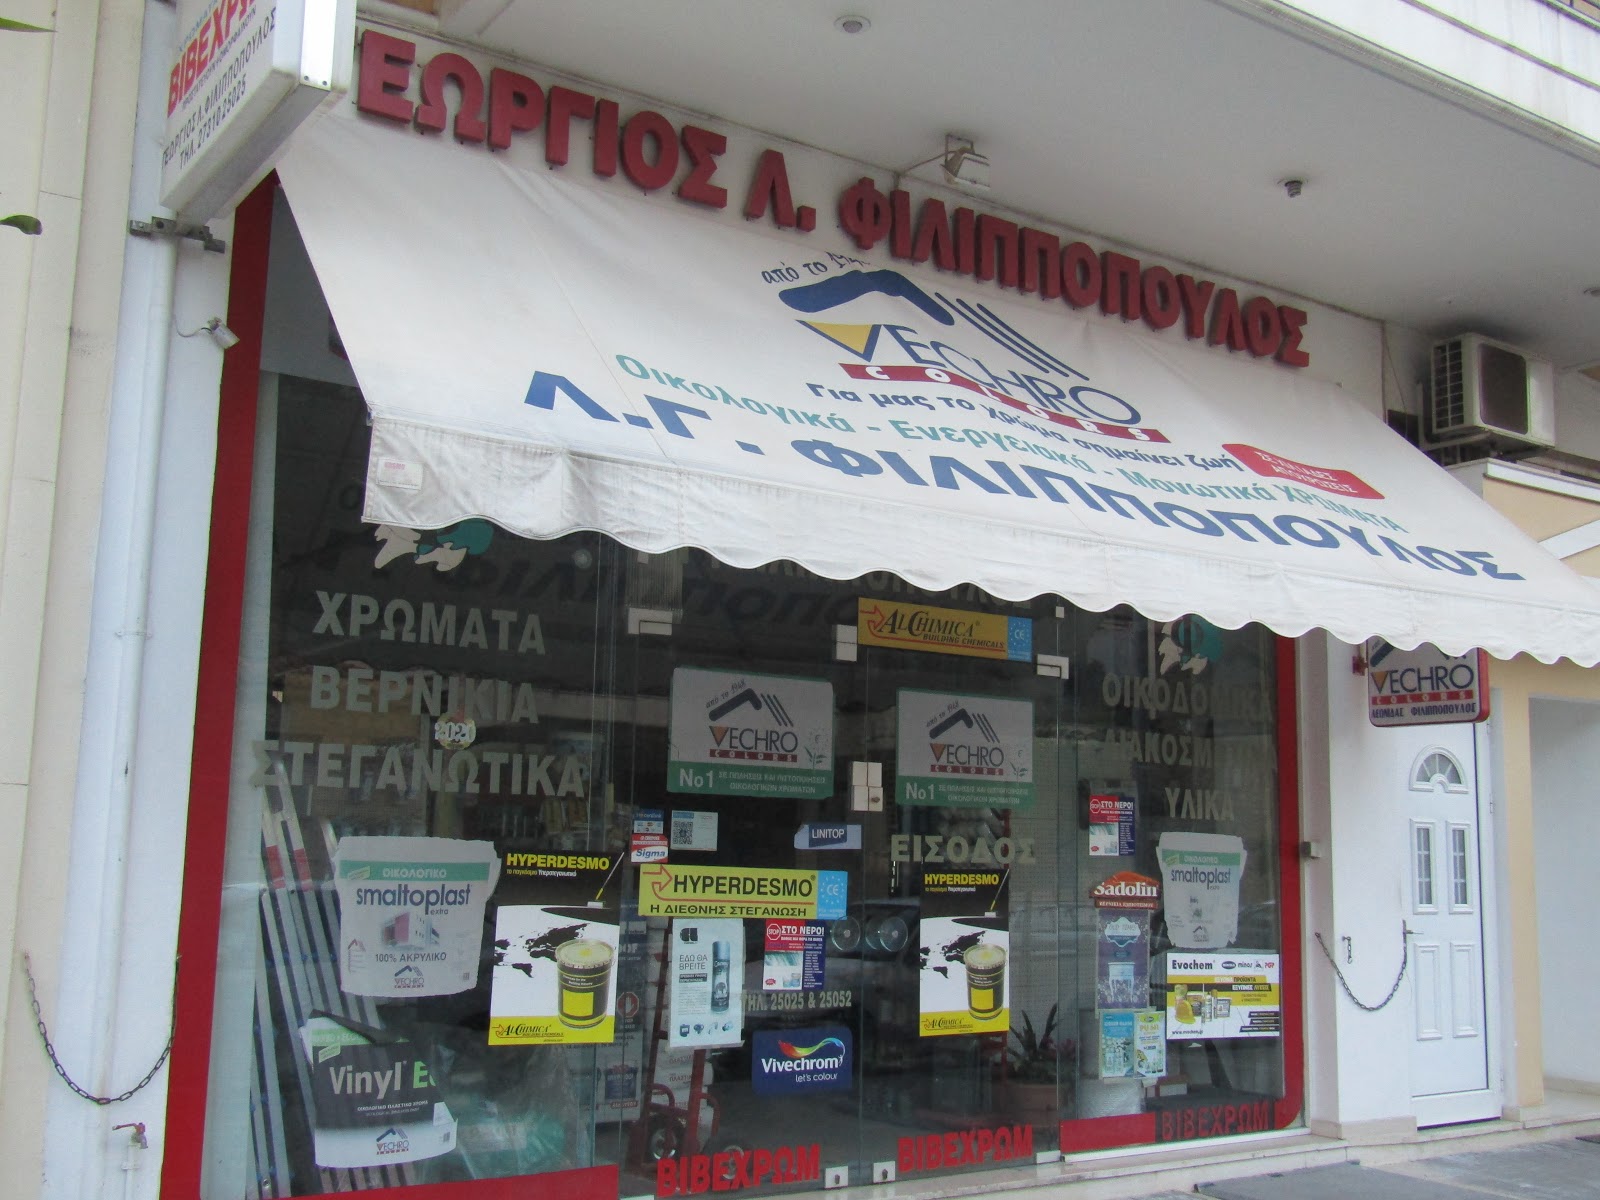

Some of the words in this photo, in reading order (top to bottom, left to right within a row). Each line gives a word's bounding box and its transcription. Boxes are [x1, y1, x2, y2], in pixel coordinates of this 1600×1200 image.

[356, 28, 727, 209] ΕΩΡΓΙΟΣ
[744, 149, 816, 233] Λ.
[838, 177, 1309, 367] ΦΙΛΙΠΠΟΠΟΥΛΟΣ
[761, 261, 800, 284] από
[802, 261, 828, 276] το
[795, 319, 1142, 426] VECHRO
[805, 382, 863, 403] Για
[869, 393, 936, 411] μας
[936, 396, 976, 411] το
[980, 403, 1064, 443] χρώμα
[1073, 437, 1184, 467] σημαίνει
[1185, 454, 1245, 473] ζωή
[615, 354, 857, 433] Οικολογικά
[888, 419, 1097, 474] Ενεργειακά
[1116, 467, 1278, 500] Μονωτικά
[1272, 483, 1409, 534] ΧΡΩΜΑΤΑ
[790, 438, 1527, 581] ΦΙΛΙΠΠΟΠΟΥΛΟΣ
[312, 590, 547, 656] ΧΡΩΜΑΤΑ
[923, 633, 960, 644] BUILDING
[961, 638, 1005, 649] CHEMICALS
[1371, 664, 1475, 695] VECHRO
[310, 665, 539, 724] ΒΕΡΝΙΚΙΑ
[1375, 691, 1467, 705] COLORS
[1410, 702, 1477, 716] ΦΙΛΙΠΠΟΠΟΥΛΟΣ
[708, 725, 798, 753] VECHRO
[714, 750, 793, 762] COLORS
[929, 742, 1004, 767] VECHRO
[248, 740, 585, 798] ΣΤΕΓΑΝΩΤΙΚΑ
[1164, 787, 1235, 821] ΥΛΙΚΑ
[811, 829, 845, 839] LINITOP
[636, 848, 666, 859] Sigma
[890, 834, 1037, 865] ΕΙΣΟΔΟΣ
[382, 867, 447, 878] ΟΙΚΟΛΟΓΙΚΟ
[506, 852, 610, 871] HYPERDESMO
[674, 874, 813, 897] HYPERDESMO
[924, 873, 1000, 885] HYPERDESMO
[1094, 881, 1158, 897] Sadolin
[1171, 867, 1231, 890] smaltoplast
[356, 883, 471, 915] smaltoplast
[650, 904, 660, 914] Η
[664, 904, 727, 915] ΔΙΕΘΝΗΣ
[729, 905, 807, 917] ΣΤΕΓΑΝΩΣΗ
[781, 925, 797, 934] ΣΤΟ
[800, 926, 825, 935] ΝΕΡΟ!
[375, 953, 397, 962] 100%
[400, 952, 447, 962] ΑΚΡΥΛΙΚΟ
[679, 954, 695, 962] ΕΔΩ
[679, 962, 706, 970] ΒΡΕΙΤΕ
[1172, 959, 1213, 970] Evochem
[771, 992, 804, 1011] 25025
[807, 992, 815, 1008] &
[820, 990, 852, 1007] 25052
[761, 1056, 839, 1073] Vivechrom
[329, 1061, 402, 1100] Vinyl
[796, 1072, 812, 1083] let's
[812, 1072, 838, 1082] colour
[1161, 1100, 1270, 1142] ΒΙΒΕΧΡΩΜ
[898, 1124, 1034, 1173] ΒΙΒΕΧΡΩΜ
[656, 1142, 821, 1199] ΒΙΒΕΧΡΩΜ
